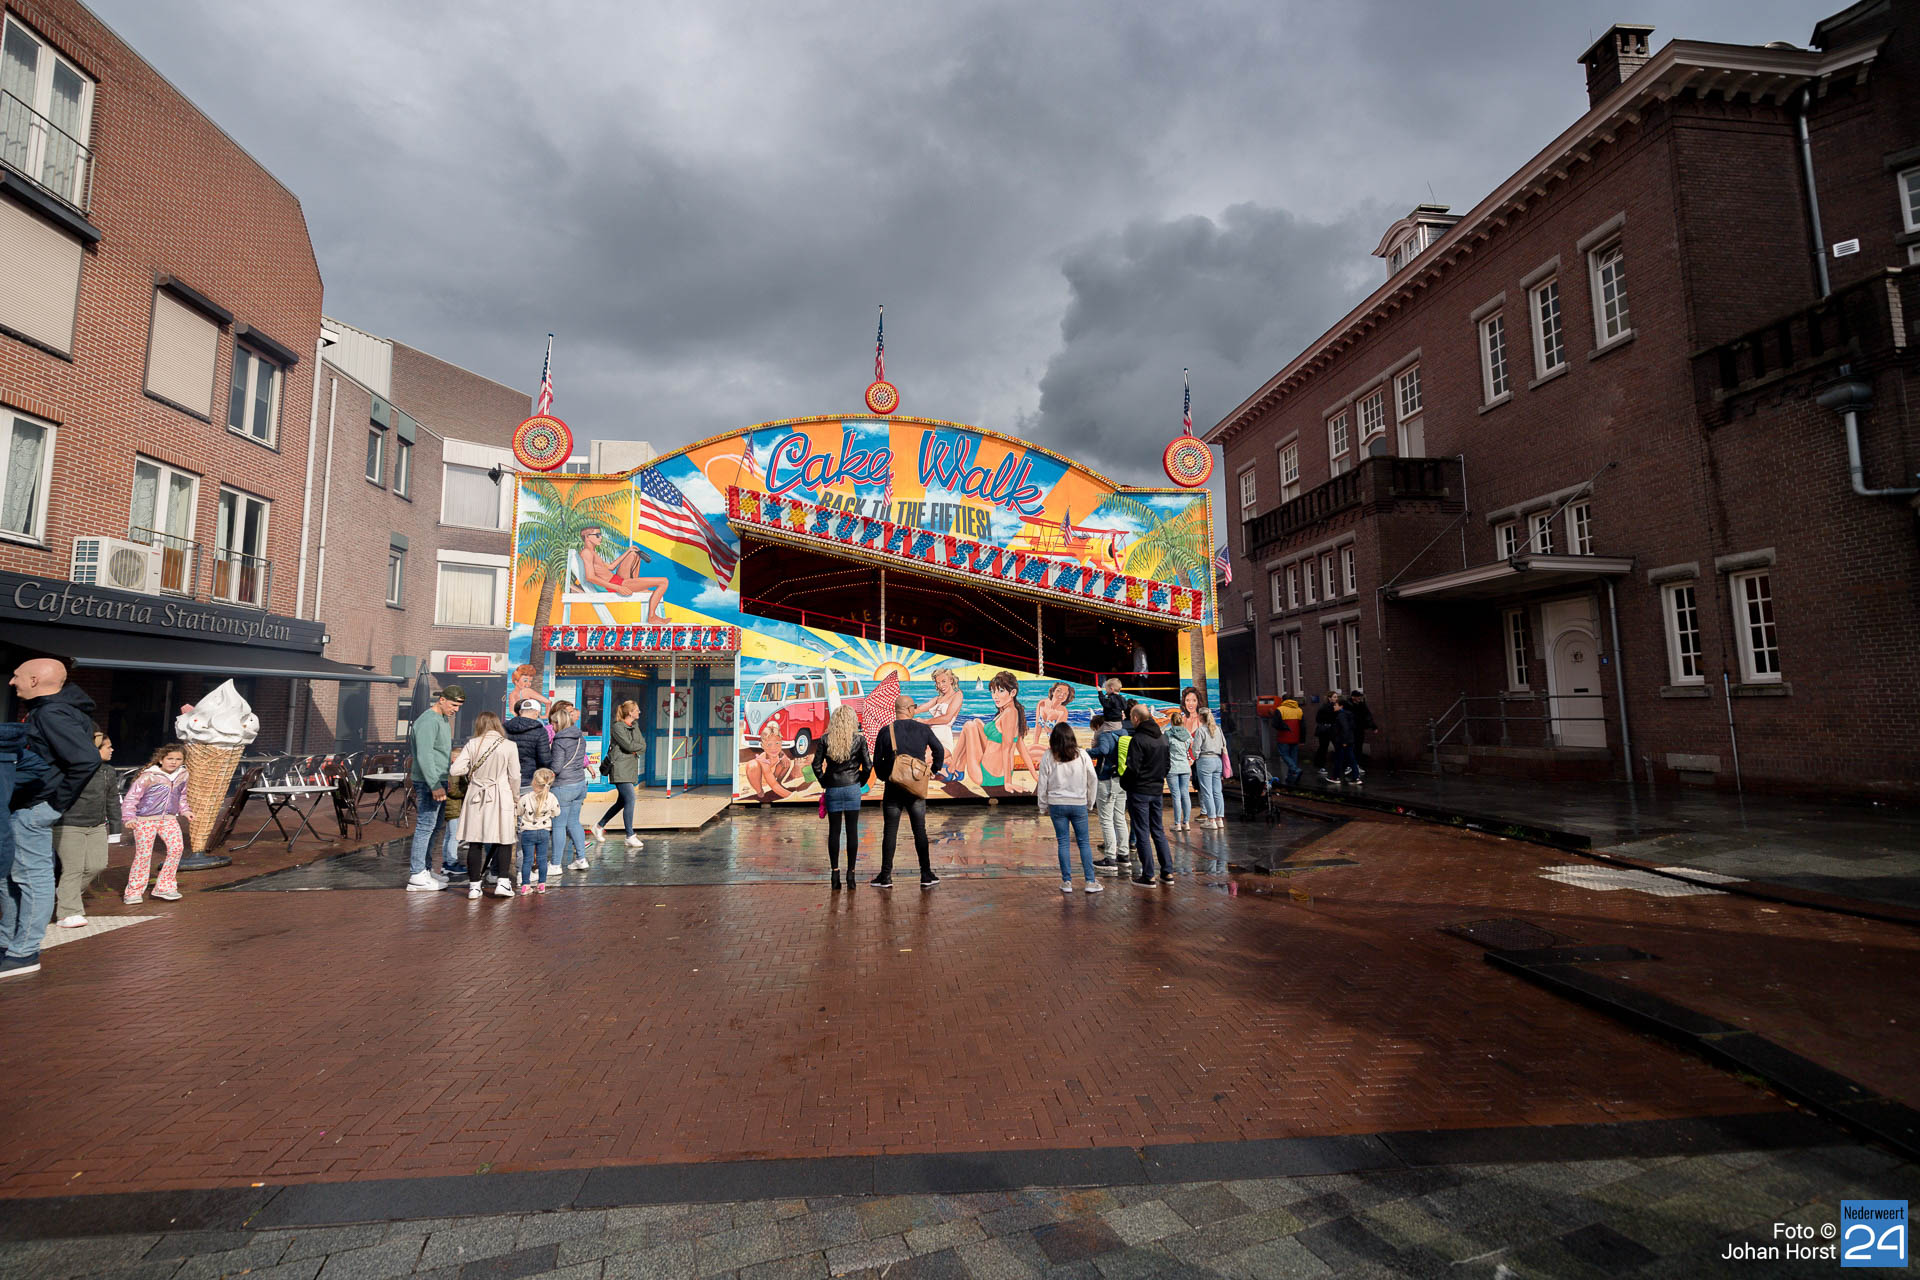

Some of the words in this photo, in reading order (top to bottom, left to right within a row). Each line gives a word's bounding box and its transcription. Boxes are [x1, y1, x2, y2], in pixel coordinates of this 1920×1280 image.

[765, 429, 894, 497] Cake
[918, 429, 1046, 517] Walk
[820, 491, 867, 517] BACK
[898, 501, 926, 528] THE
[930, 502, 993, 541] FIFTIES!
[810, 509, 936, 558] SUPER
[949, 543, 1126, 599] SJIMMIE
[13, 581, 153, 624] Cafetaria
[160, 603, 291, 643] Stationsplein
[588, 630, 728, 648] HOEFNAGELS
